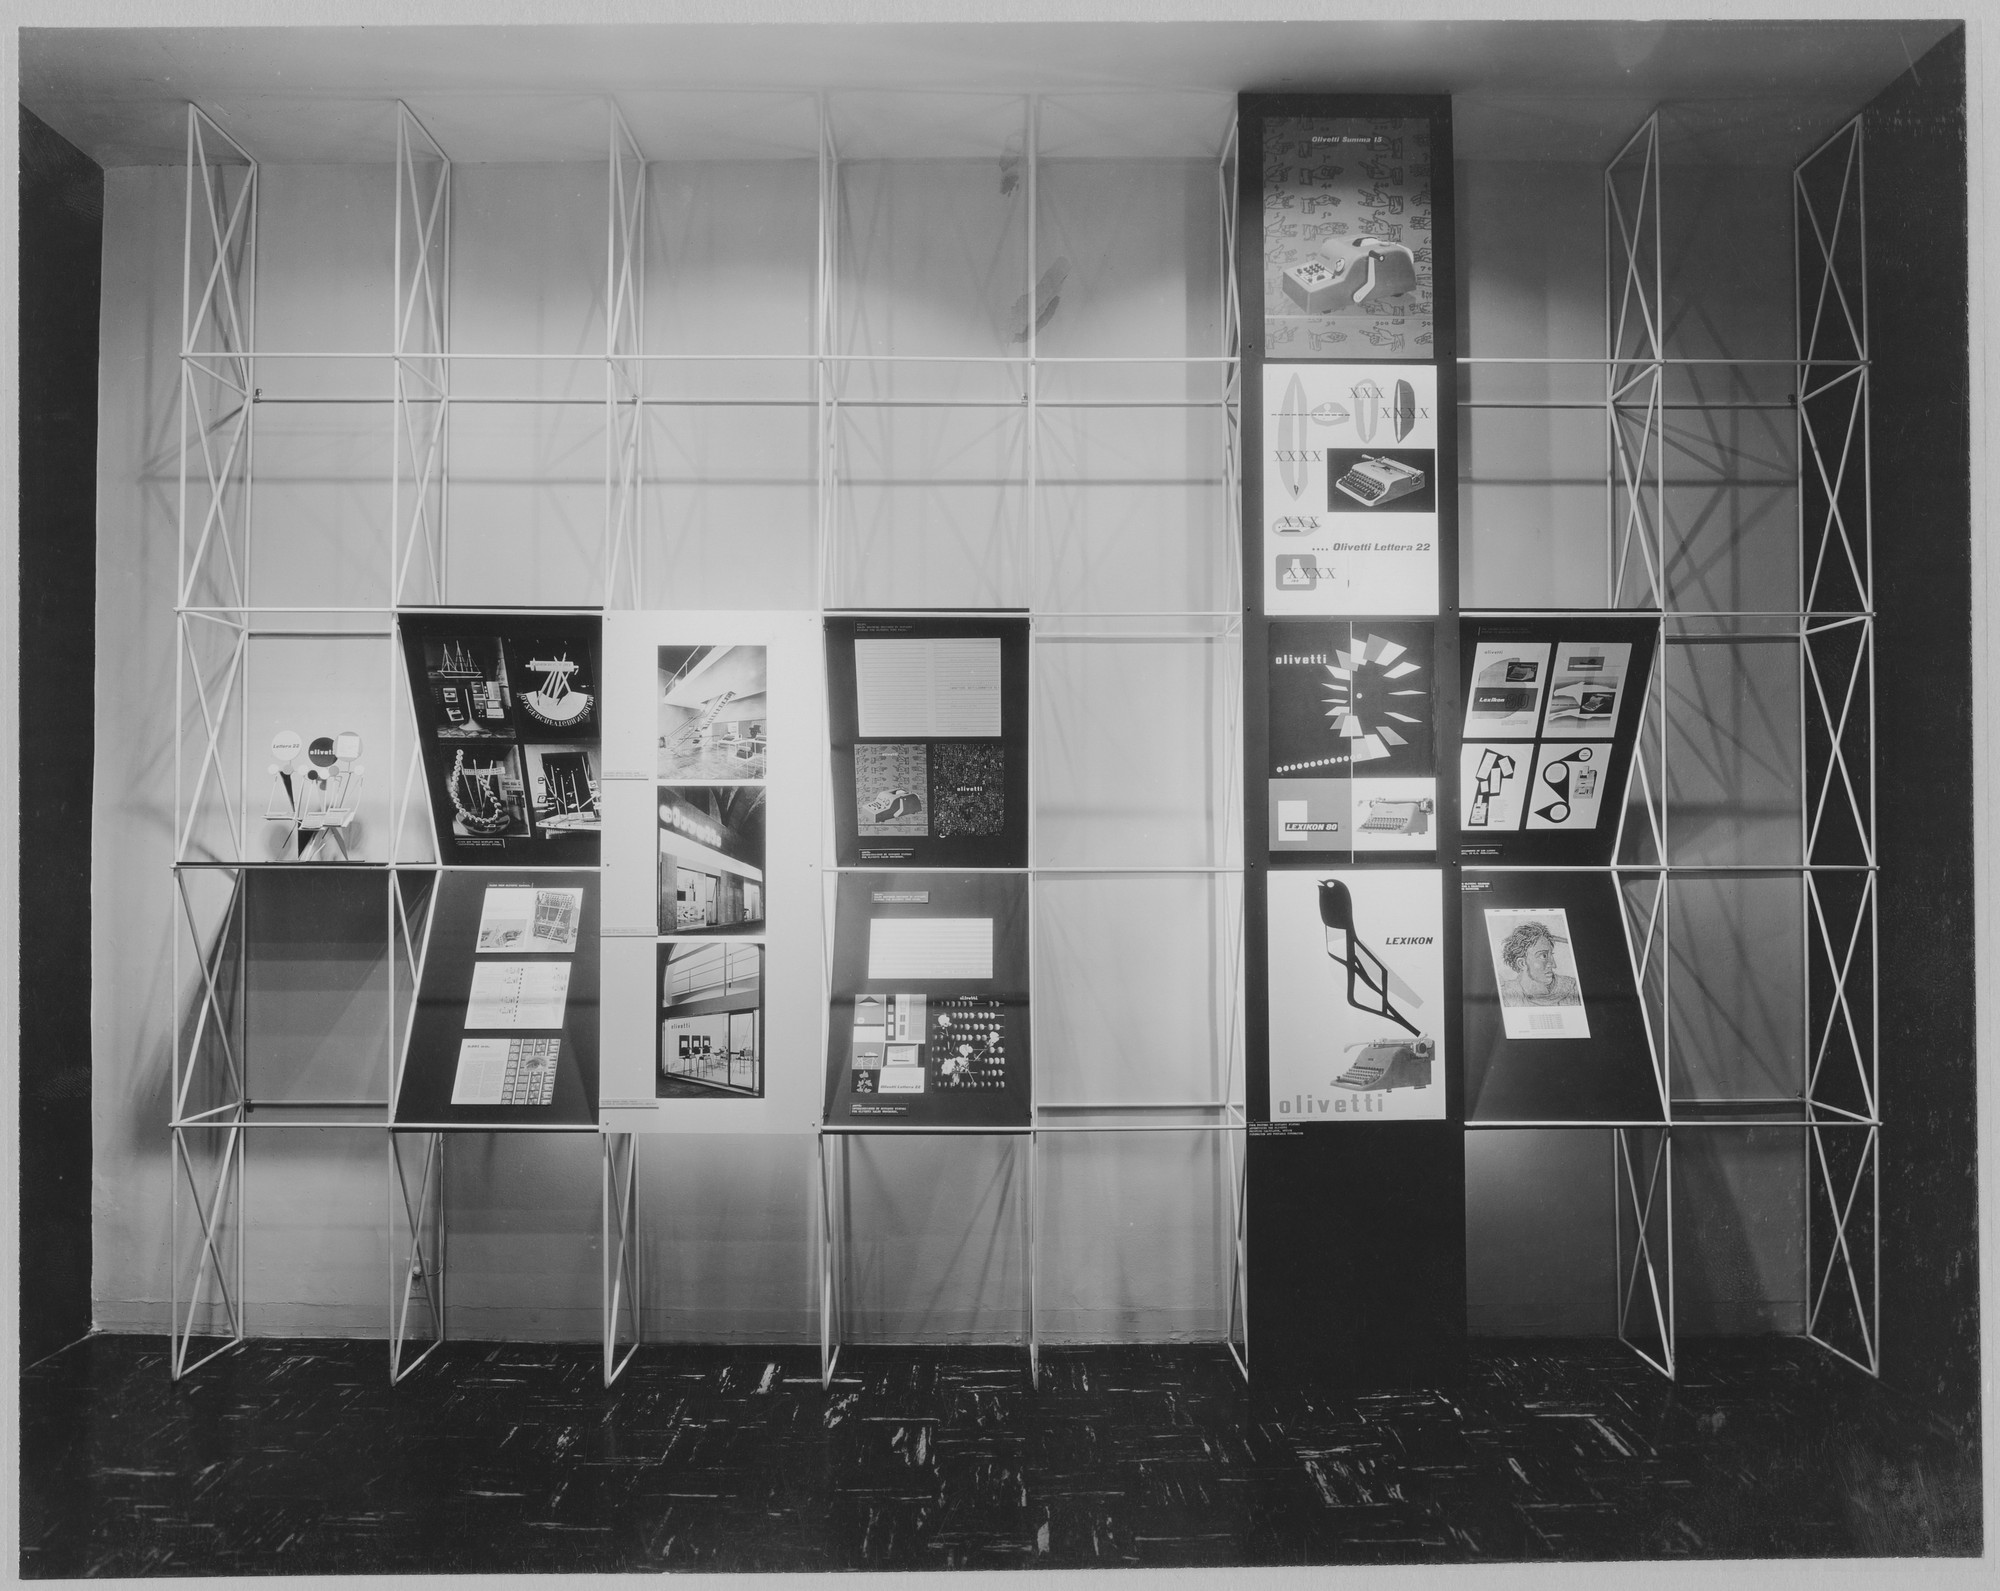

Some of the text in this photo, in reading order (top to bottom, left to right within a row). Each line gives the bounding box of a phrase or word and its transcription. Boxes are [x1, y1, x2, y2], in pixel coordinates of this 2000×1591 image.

[1333, 543, 1372, 551] Olivetti
[1374, 543, 1413, 551] Lettera
[1416, 543, 1431, 551] 22
[1275, 654, 1327, 665] olivetti
[1286, 823, 1338, 831] LEXIKON 80
[1385, 936, 1434, 945] LEXIKON
[1279, 1094, 1383, 1114] olivetti
